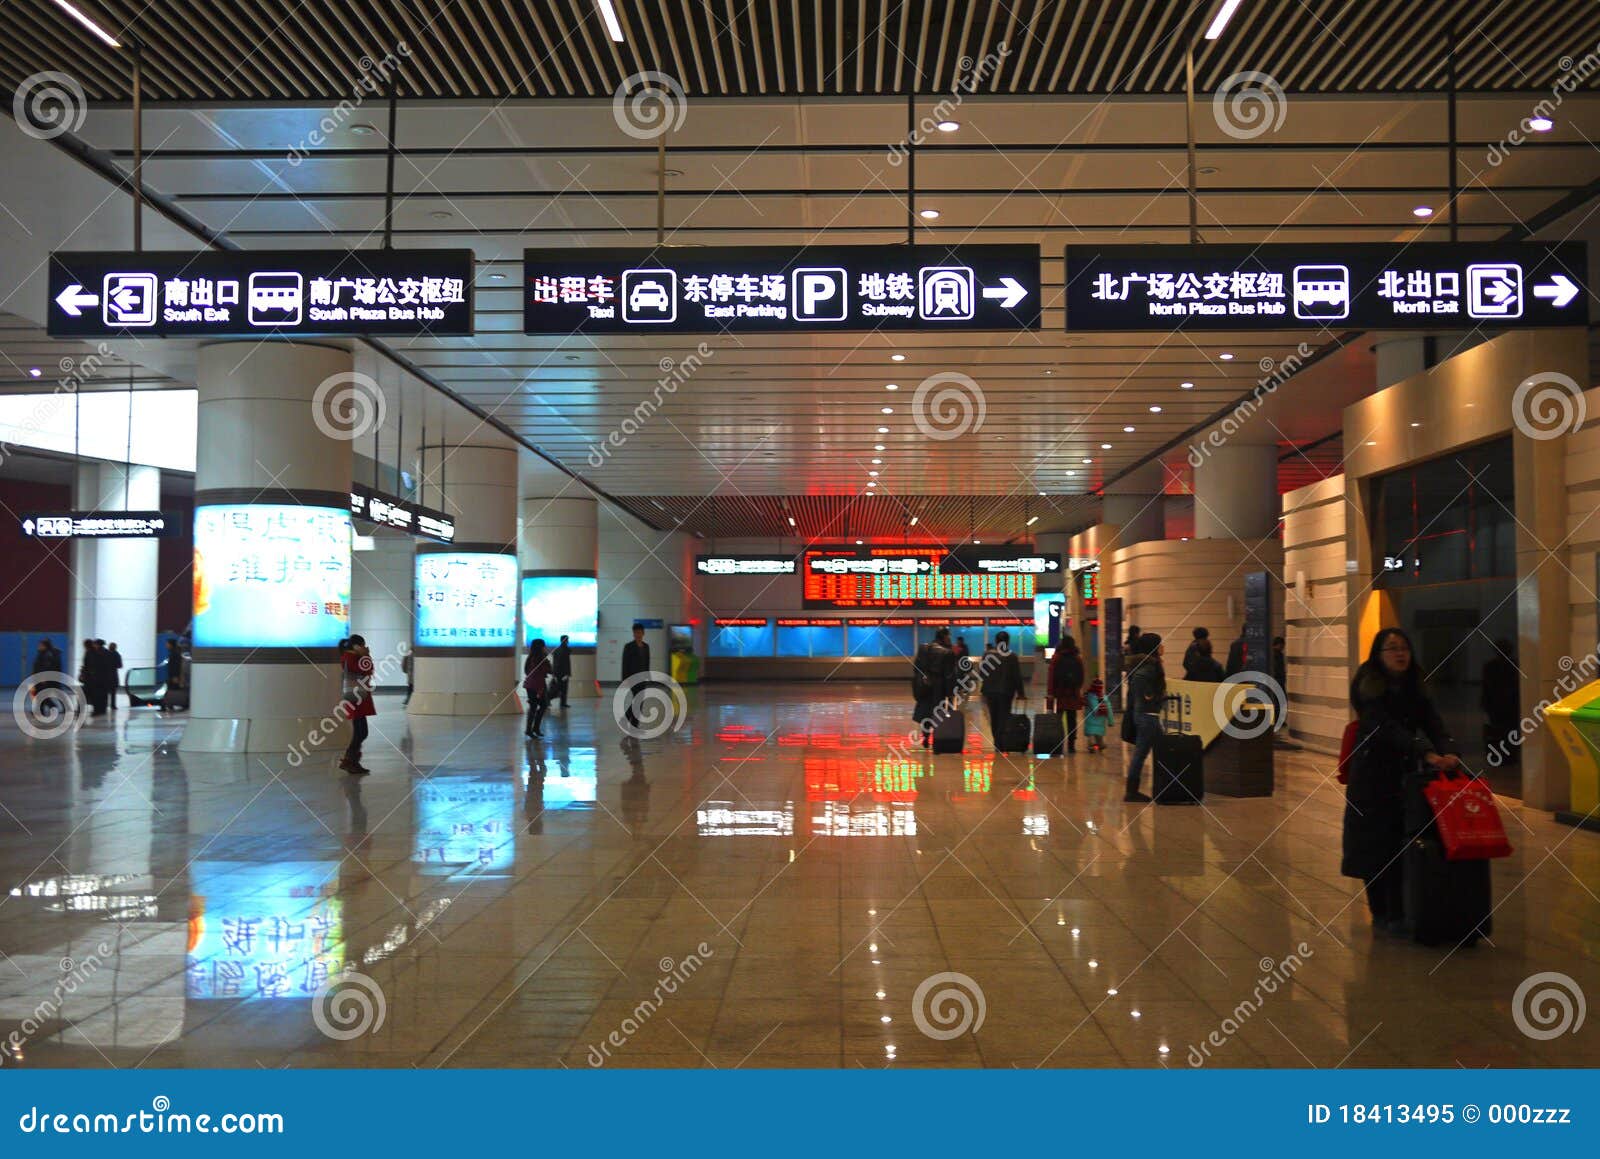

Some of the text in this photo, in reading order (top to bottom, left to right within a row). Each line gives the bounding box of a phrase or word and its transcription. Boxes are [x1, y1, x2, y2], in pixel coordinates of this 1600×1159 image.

[164, 278, 239, 307] 南出口
[309, 277, 464, 306] 南广场公交枢纽
[534, 276, 615, 304] 出租车
[683, 274, 786, 302] 东停车场
[858, 273, 914, 301] 地铁
[1092, 272, 1286, 301] 北广场公交枢纽
[1378, 270, 1460, 299] 北出口
[164, 308, 229, 322] South Exit
[309, 307, 444, 321] South Plaza Bus Hub
[587, 306, 614, 318] Taxi
[705, 304, 786, 320] East Parking
[862, 303, 915, 319] Subway
[1150, 302, 1285, 315] North Plaza Bus Hub
[1393, 301, 1458, 313] North Exit
